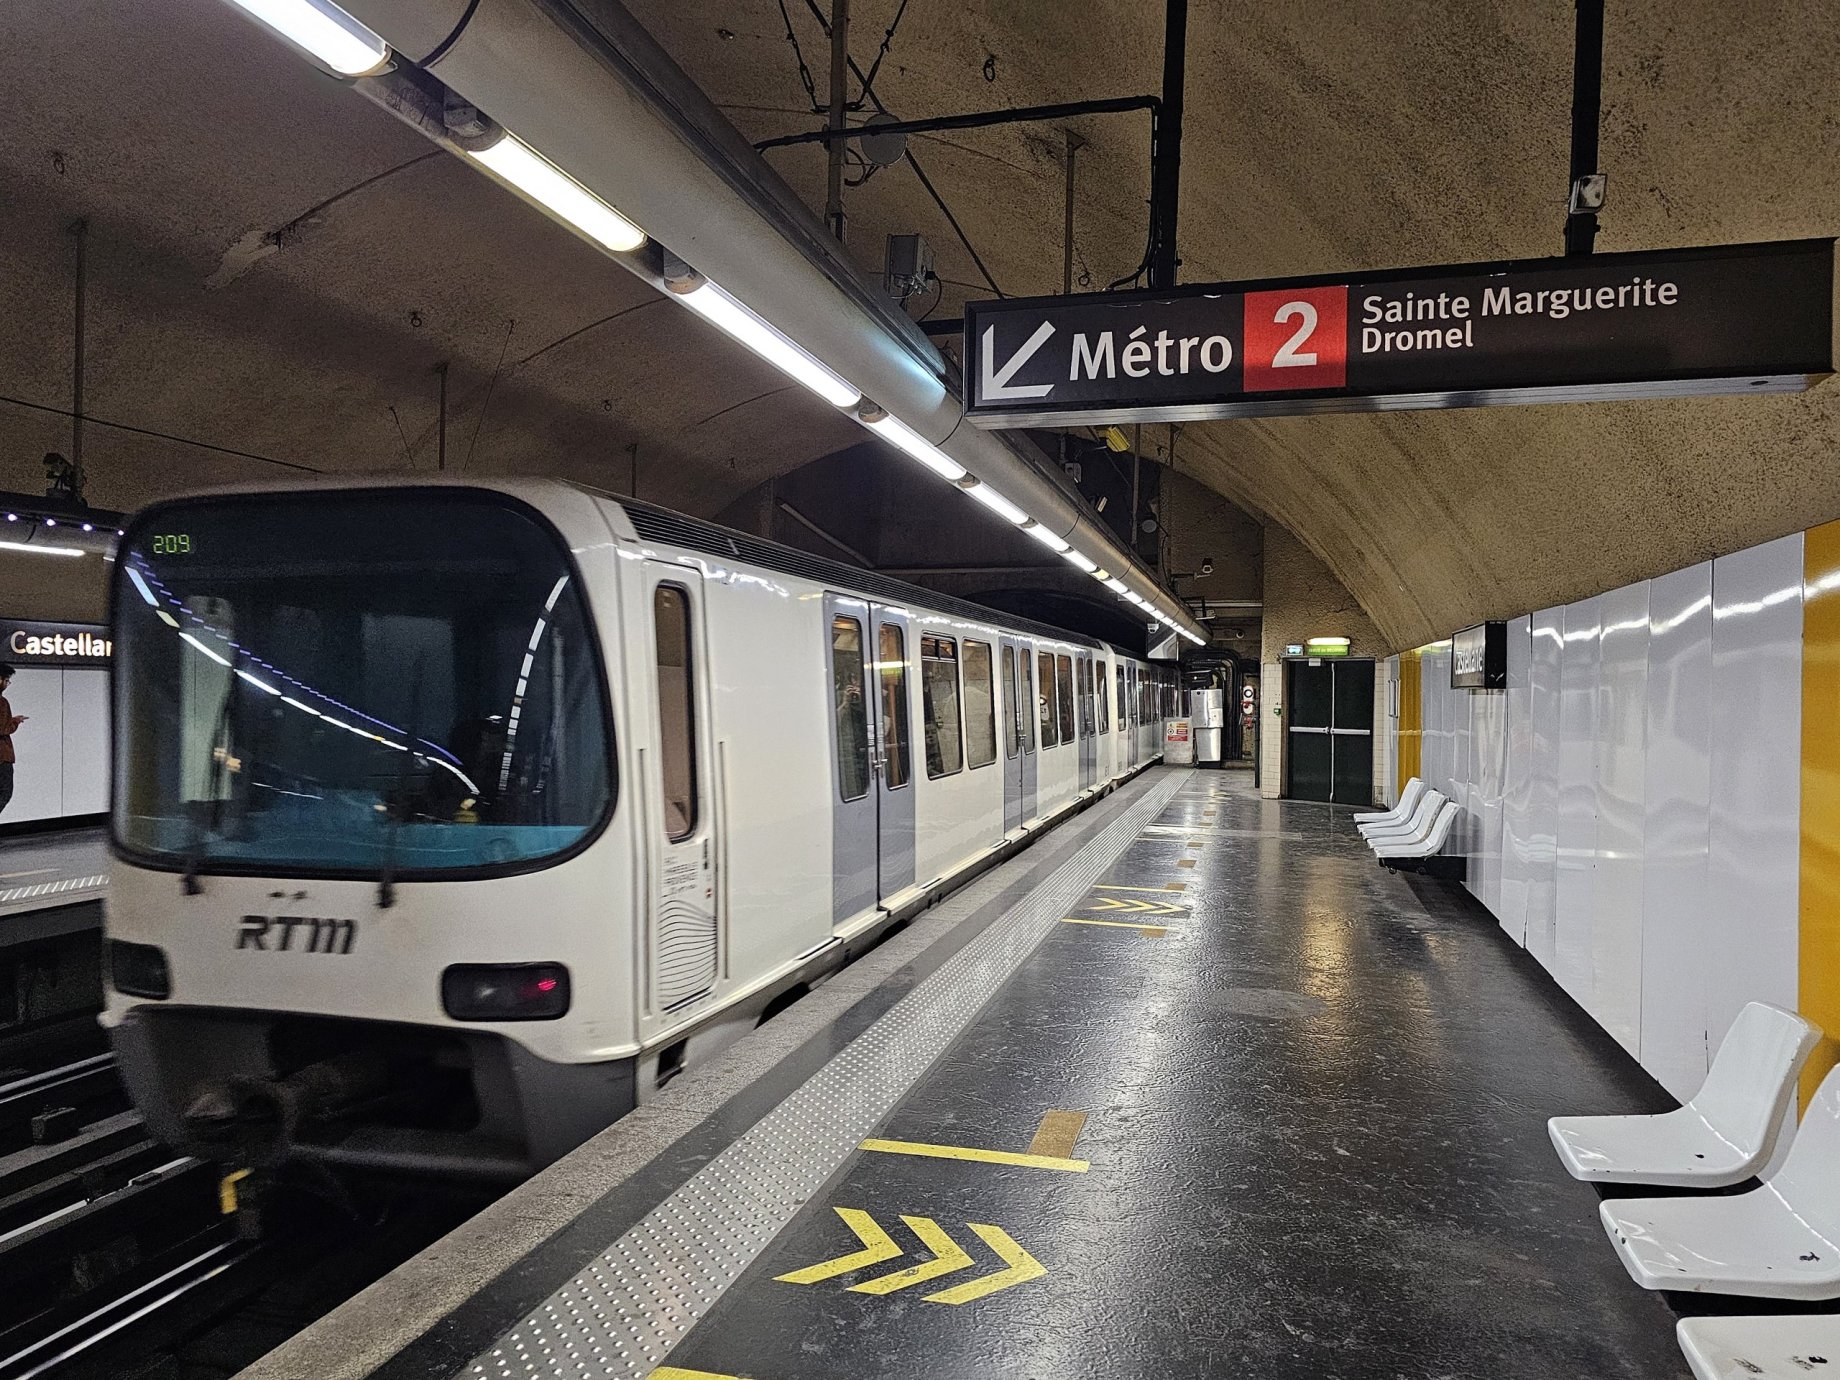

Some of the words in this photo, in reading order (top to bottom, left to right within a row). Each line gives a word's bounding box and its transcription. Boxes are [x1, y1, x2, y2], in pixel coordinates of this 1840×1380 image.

[1361, 292, 1470, 324] Sainte
[1481, 276, 1679, 319] Marguerite
[1069, 325, 1233, 382] Métro
[1271, 301, 1318, 368] 2
[1361, 320, 1474, 353] Dromel
[152, 534, 190, 554] 209
